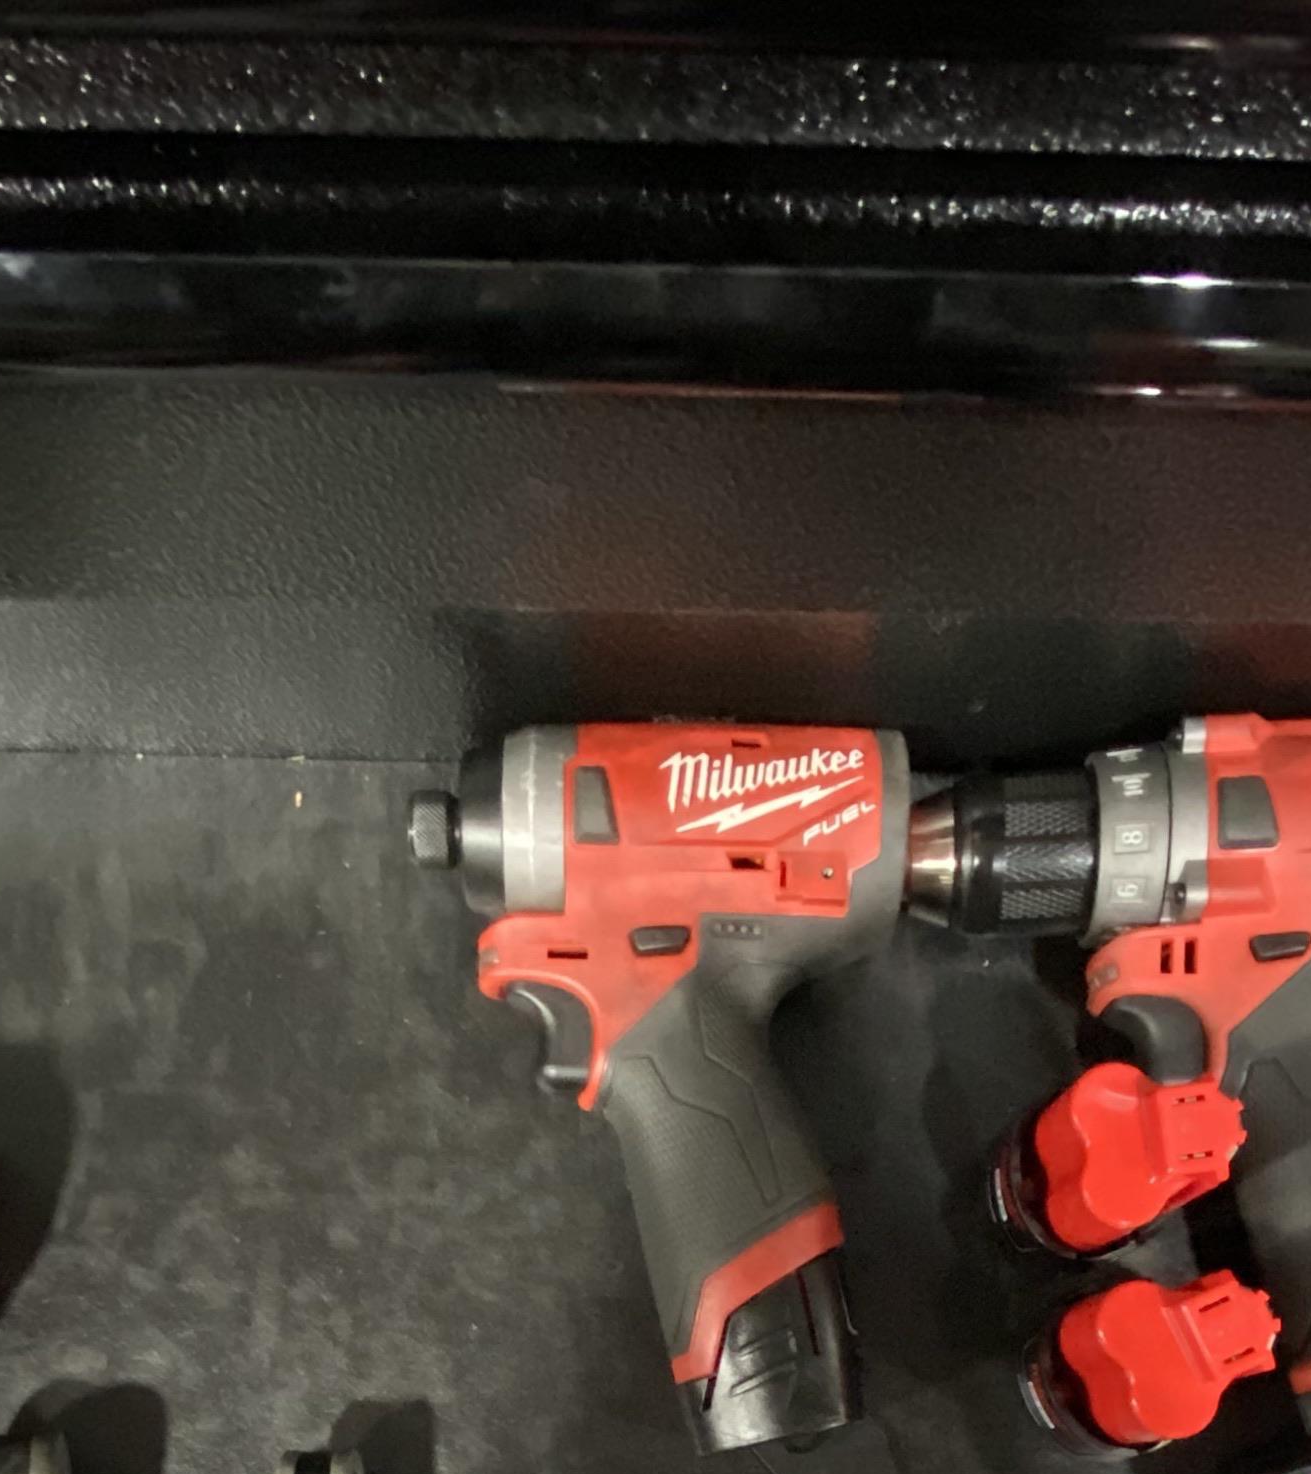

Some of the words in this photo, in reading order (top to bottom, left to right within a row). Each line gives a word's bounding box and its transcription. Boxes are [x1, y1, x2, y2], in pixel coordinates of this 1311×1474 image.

[658, 748, 865, 813] Milwaukee
[802, 800, 877, 846] FUEL
[1121, 829, 1144, 845] 8
